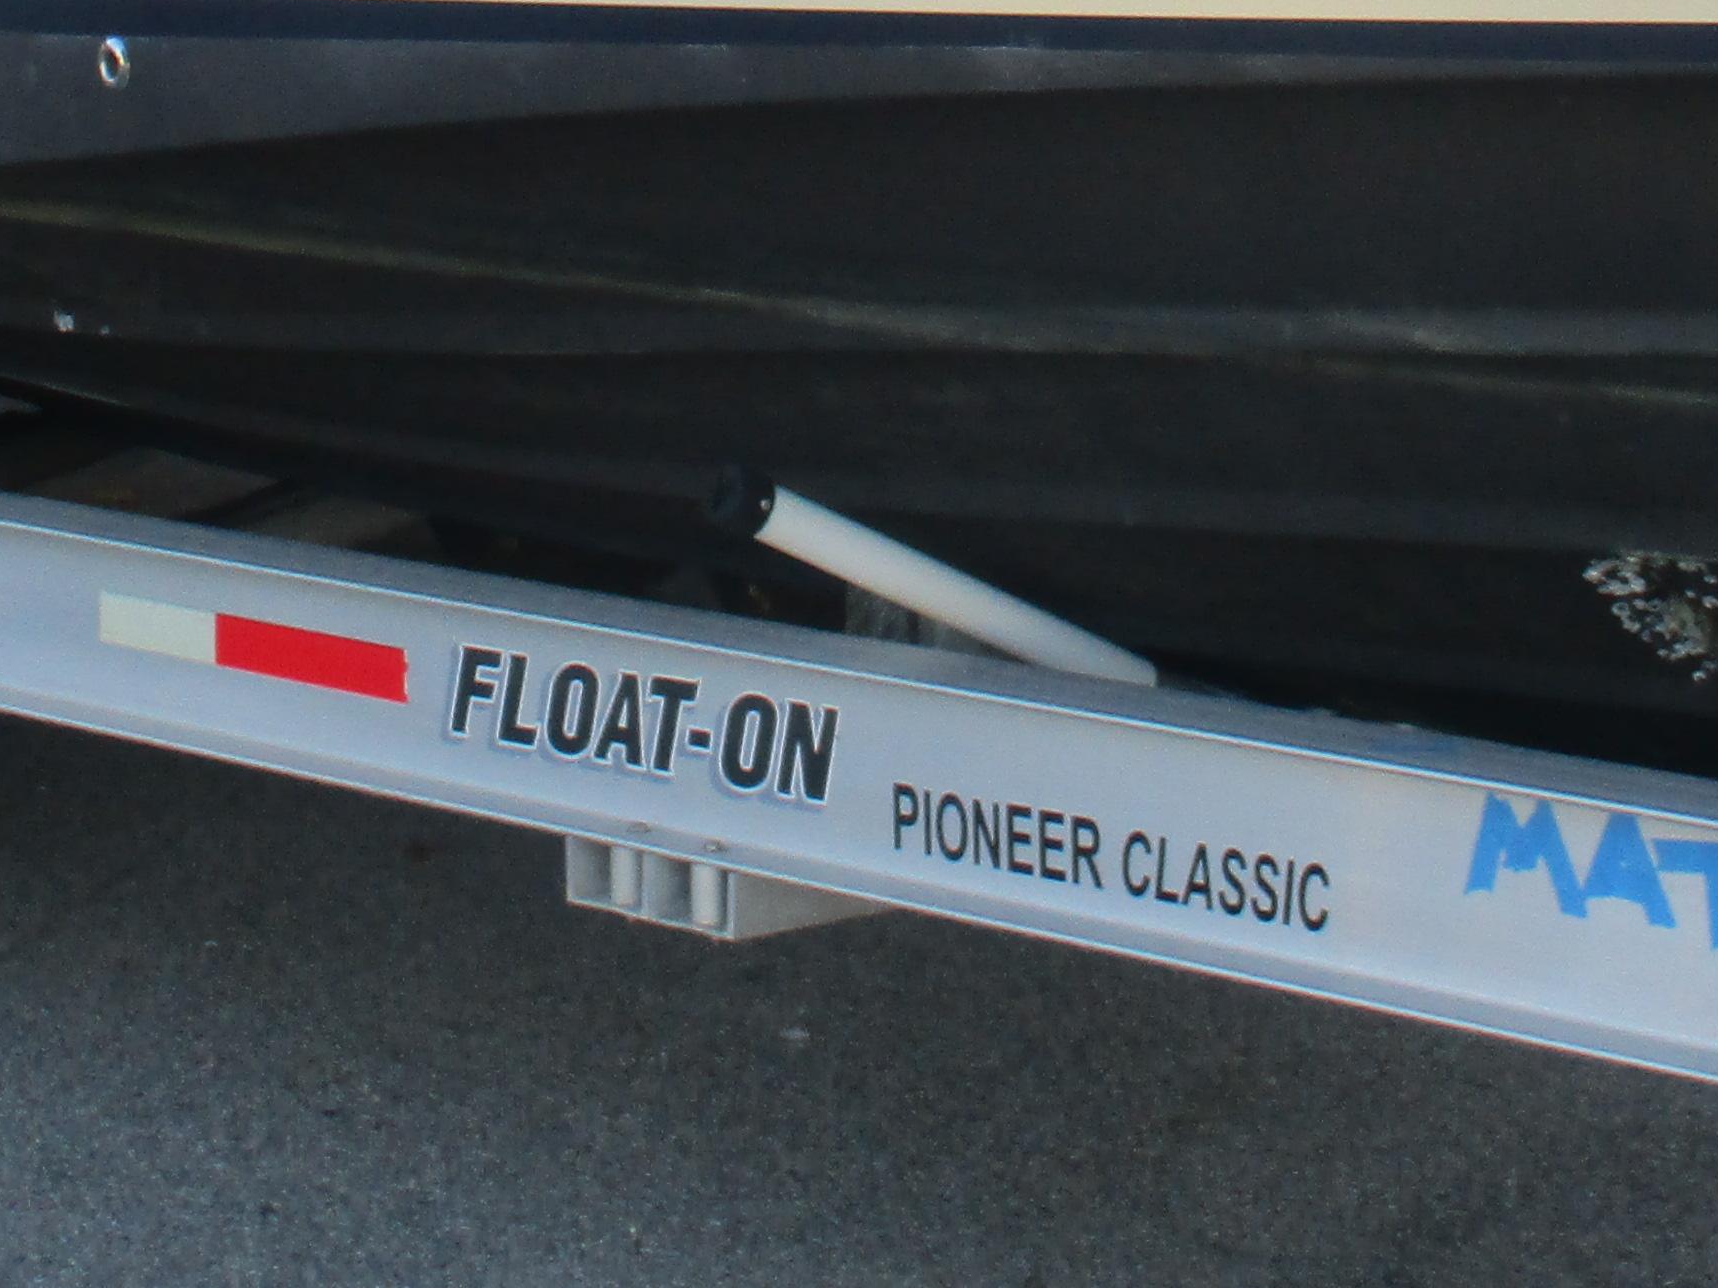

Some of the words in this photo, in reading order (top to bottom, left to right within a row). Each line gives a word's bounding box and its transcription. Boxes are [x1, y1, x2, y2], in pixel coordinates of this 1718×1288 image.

[449, 641, 840, 806] FLOAT-ON
[891, 781, 1102, 891] PIONEER
[1121, 830, 1331, 933] CLASSIC
